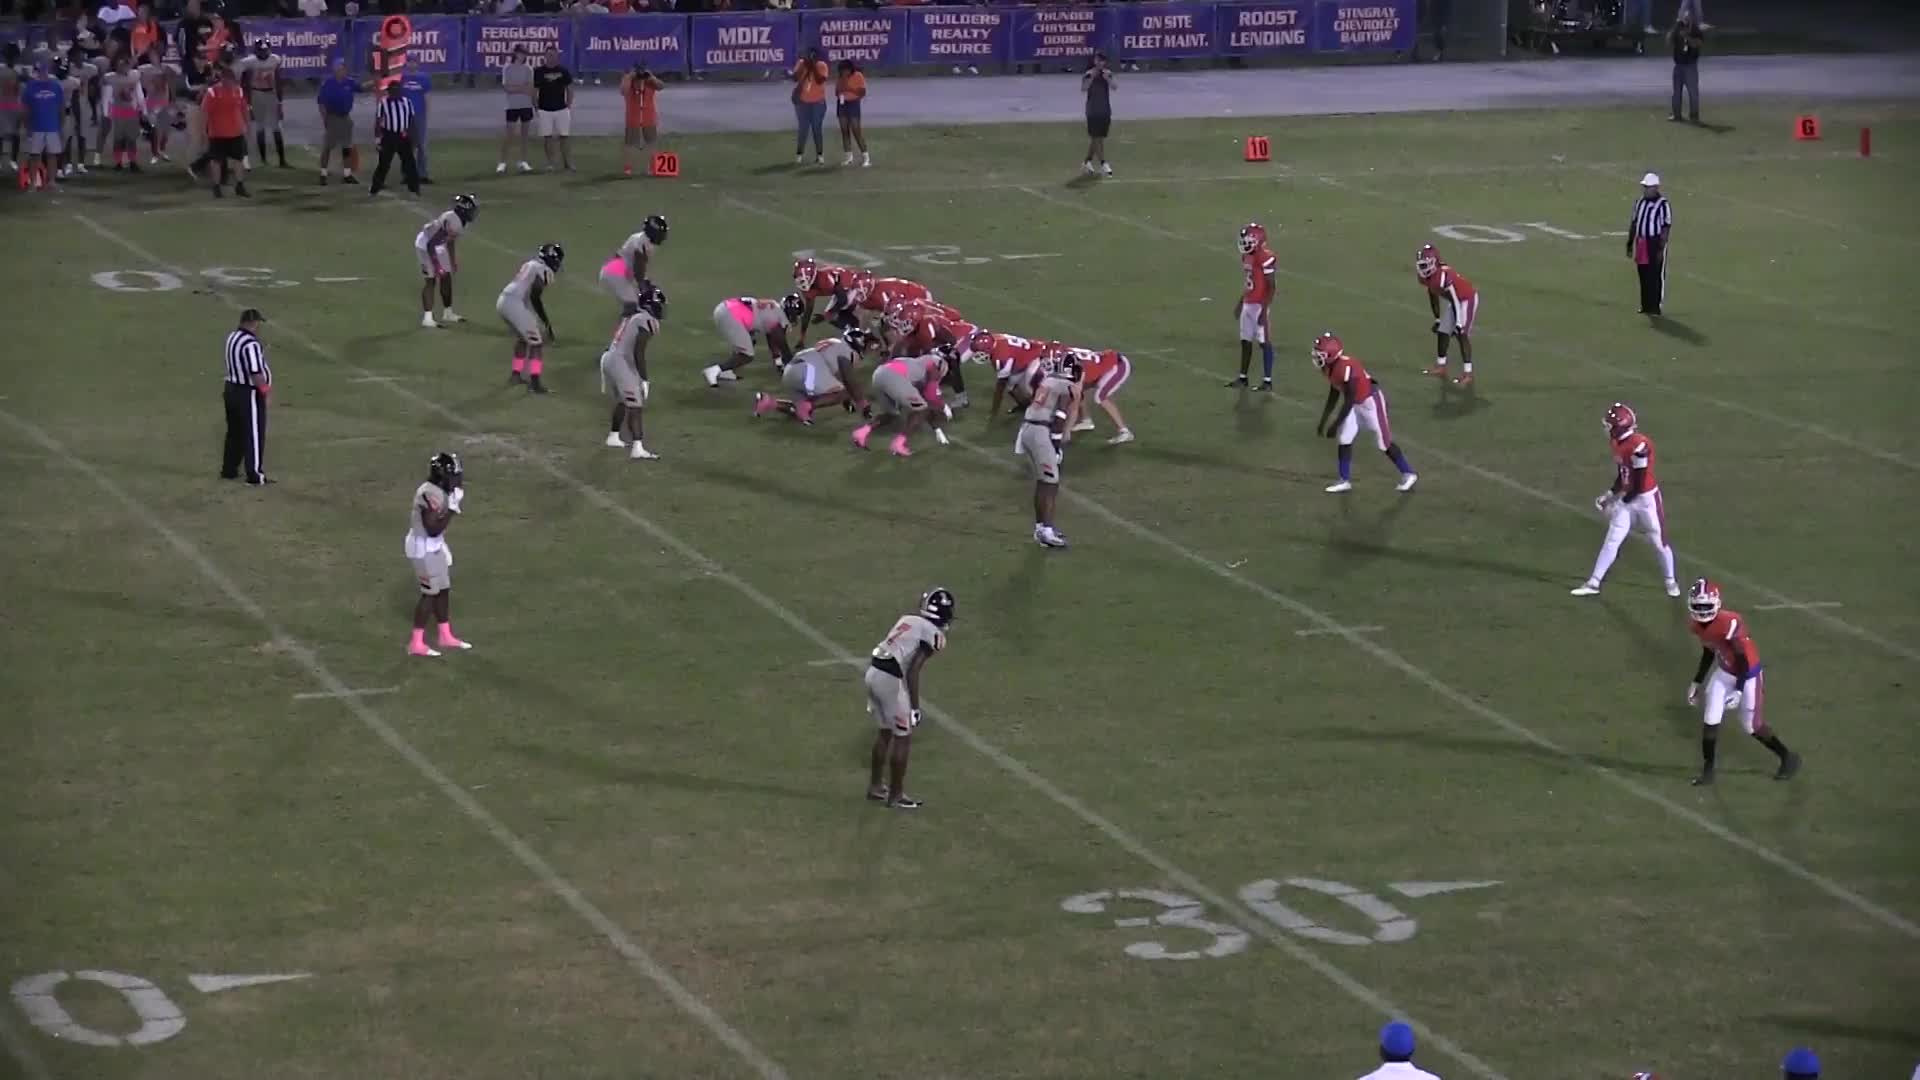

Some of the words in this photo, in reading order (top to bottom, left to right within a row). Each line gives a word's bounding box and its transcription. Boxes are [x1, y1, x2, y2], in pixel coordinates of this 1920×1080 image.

[924, 13, 1001, 26] BUILDERS
[1035, 11, 1094, 22] THUNDER
[1239, 10, 1298, 27] ROOST
[1338, 7, 1396, 20] STINGRAY
[820, 19, 892, 33] AMERICAN
[1033, 22, 1096, 33] CHRYSLER
[1143, 15, 1163, 30] ON
[1165, 14, 1192, 29] SITE
[1334, 18, 1400, 32] CHEVROLET
[482, 26, 559, 39] FERGUSON
[932, 28, 992, 40] REALTY
[1230, 30, 1305, 47] LENDING
[286, 31, 337, 49] Kollege
[586, 36, 611, 51] Jim
[613, 34, 660, 51] Valenti
[661, 34, 679, 51] PA
[821, 33, 889, 47] BUILDERS
[1043, 35, 1085, 45] DODGE
[1124, 34, 1162, 49] FLEET
[1164, 33, 1209, 48] MAINT.
[828, 48, 882, 61] SUPPLY
[930, 42, 992, 54] SOURCE
[1033, 46, 1063, 57] JEEP
[706, 48, 784, 65] COLLECTIONS
[1802, 119, 1815, 137] G
[1251, 138, 1269, 158] 10
[657, 154, 677, 173] 20
[1061, 876, 1418, 960] 30
